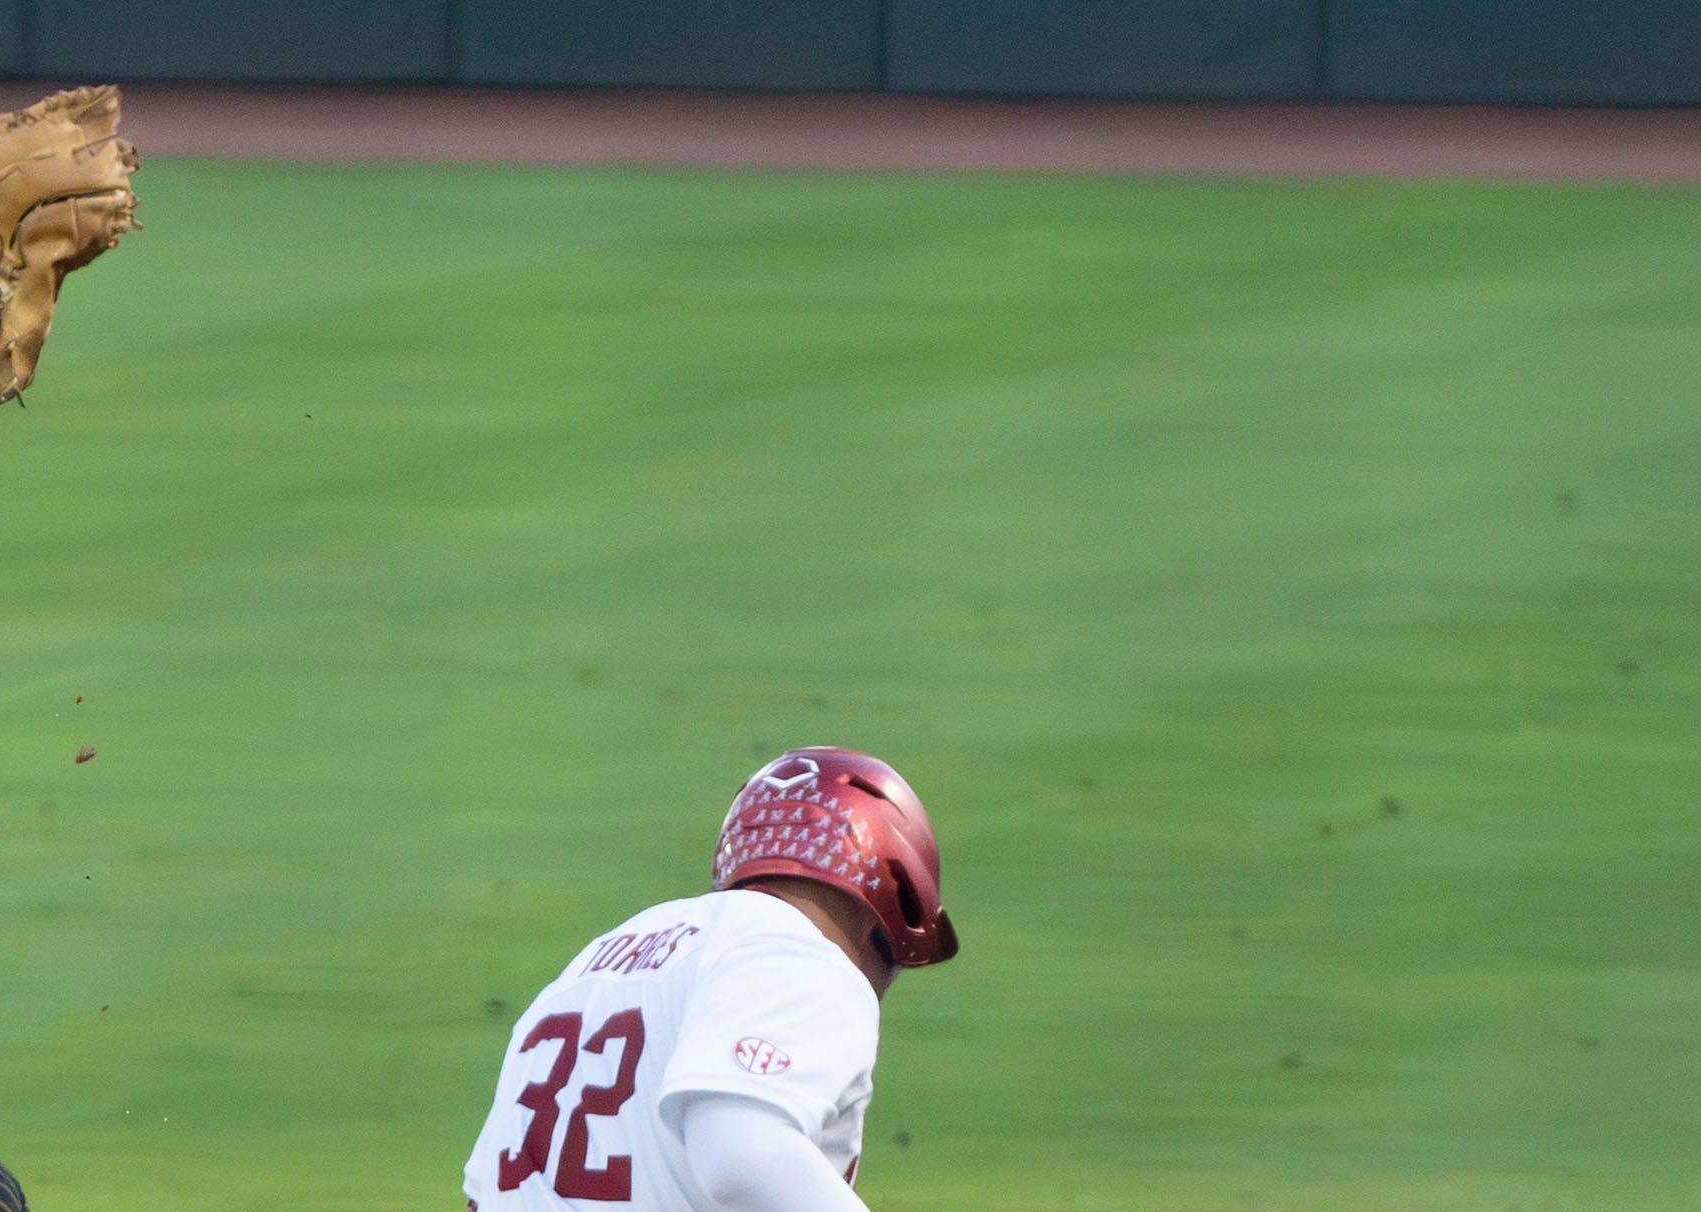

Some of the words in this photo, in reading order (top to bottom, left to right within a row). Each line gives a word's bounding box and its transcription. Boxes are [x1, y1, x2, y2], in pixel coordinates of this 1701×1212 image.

[578, 922, 700, 975] TORRES
[735, 1037, 791, 1074] SEC
[498, 1006, 645, 1202] 32
